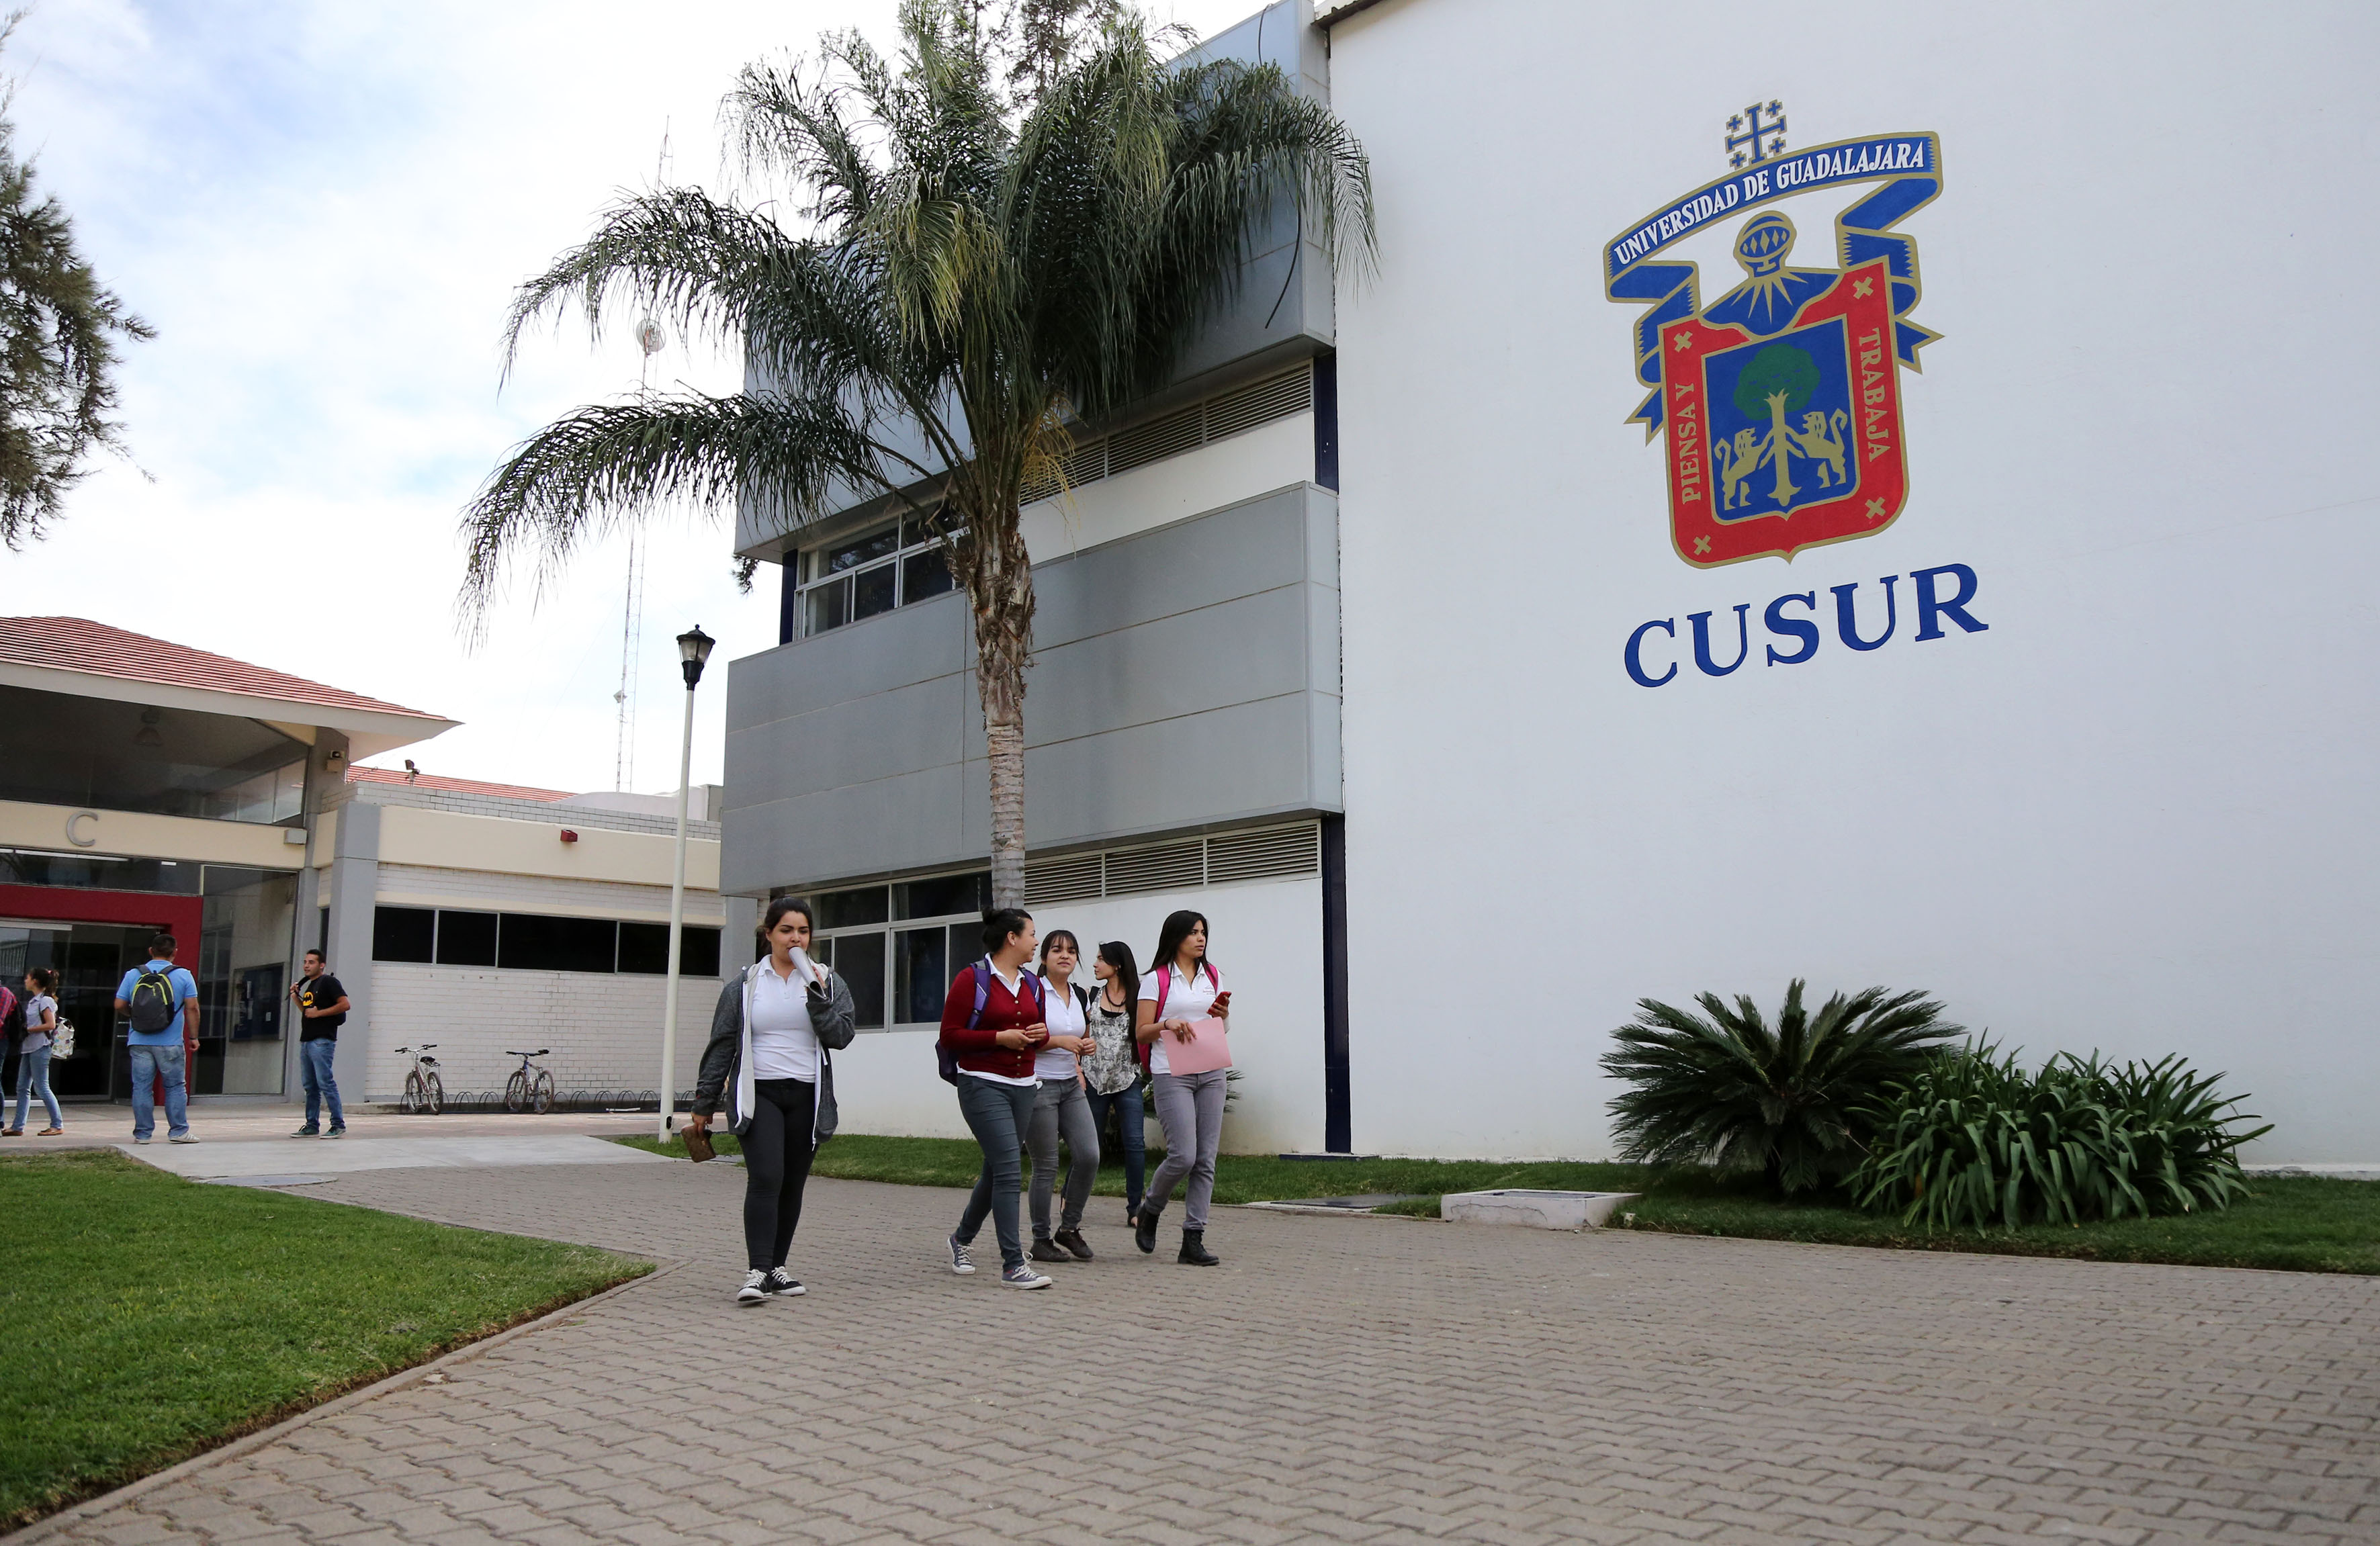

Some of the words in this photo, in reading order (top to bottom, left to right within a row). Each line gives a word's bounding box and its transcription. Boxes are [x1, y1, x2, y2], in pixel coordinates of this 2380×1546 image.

[1614, 183, 1739, 265] UNIVERSIDAD
[1743, 169, 1770, 201] DE
[1776, 141, 1925, 189] GUADALAJARA
[1675, 382, 1695, 401] Y
[1859, 327, 1890, 462] TRABAJA
[1677, 402, 1702, 504] PIENSA
[1624, 563, 1988, 687] CUSUR
[67, 810, 99, 847] C
